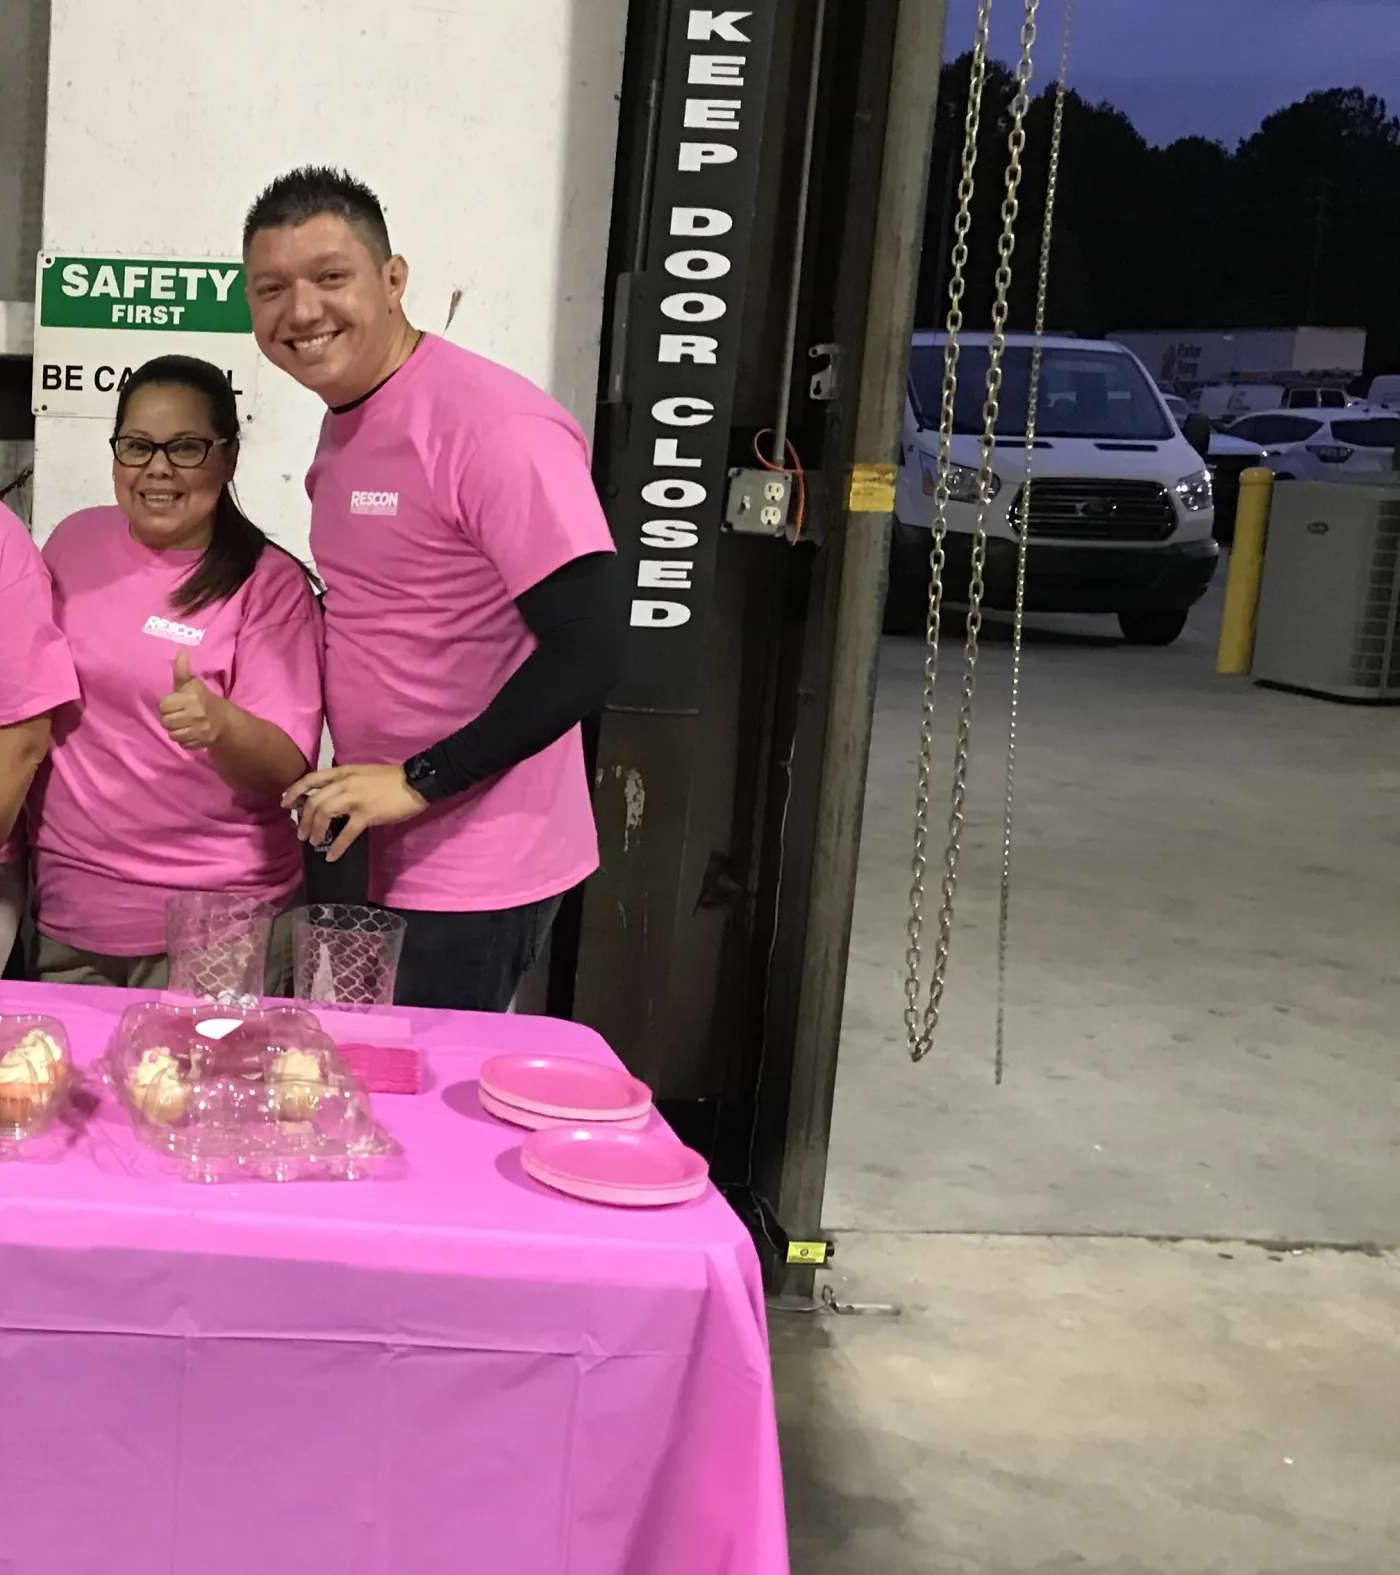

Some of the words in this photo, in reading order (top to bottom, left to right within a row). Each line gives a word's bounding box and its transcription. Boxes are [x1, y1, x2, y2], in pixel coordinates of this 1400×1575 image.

[678, 10, 753, 171] KEEP
[61, 263, 239, 302] SAFETY
[658, 207, 733, 364] DOOR
[111, 304, 185, 325] FIRST
[42, 364, 84, 391] BE
[350, 490, 399, 507] RESCON
[630, 397, 715, 628] CLOSED
[144, 615, 207, 641] RESCON
